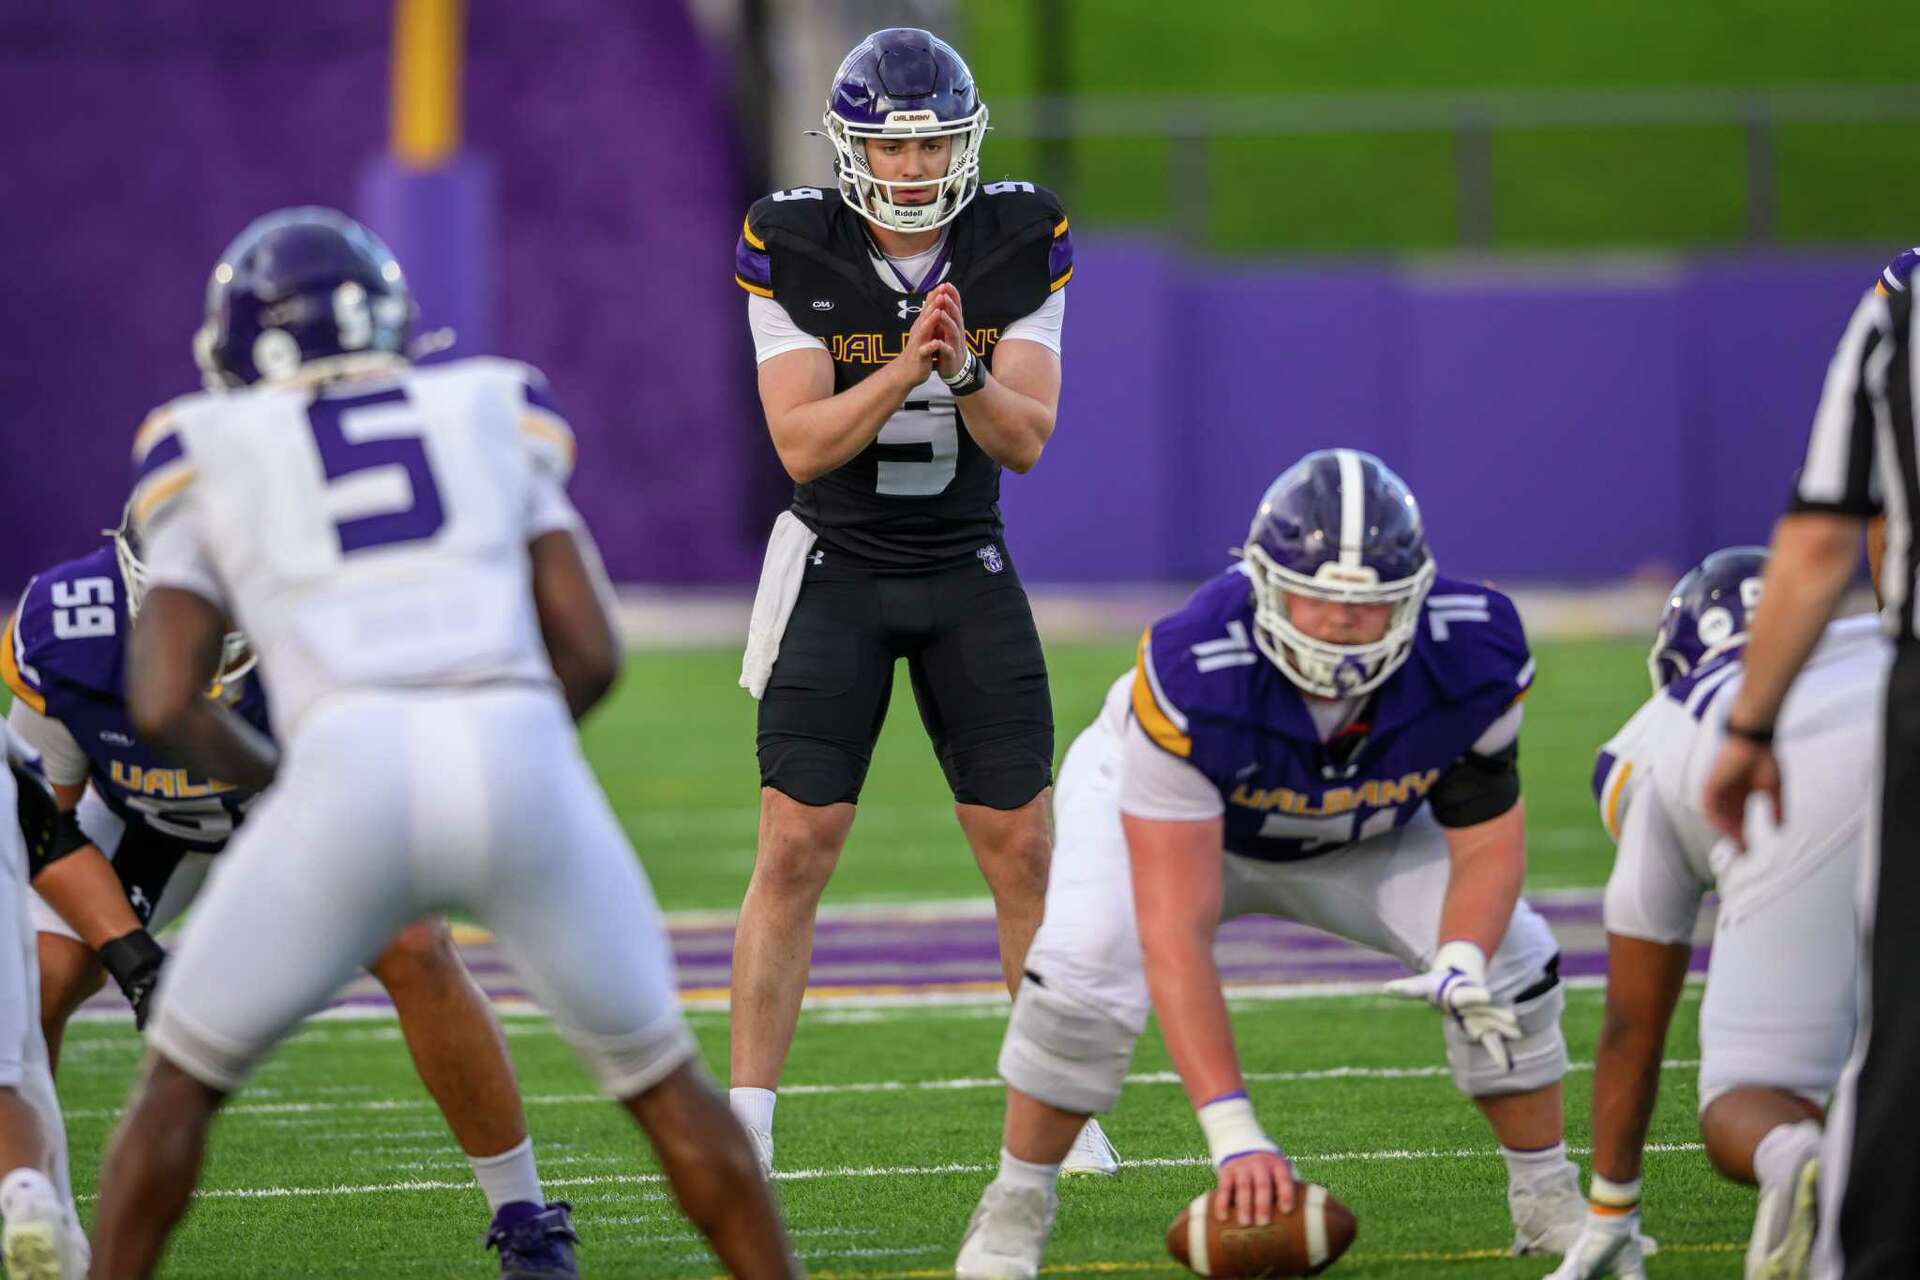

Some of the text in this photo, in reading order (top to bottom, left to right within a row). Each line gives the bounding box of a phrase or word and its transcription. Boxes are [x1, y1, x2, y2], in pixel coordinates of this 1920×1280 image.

[893, 114, 930, 122] UALBANY
[894, 209, 923, 217] Riddell
[305, 388, 447, 554] 5
[51, 576, 116, 640] 59
[1190, 620, 1258, 674] 71
[1230, 768, 1441, 816] UALBANY
